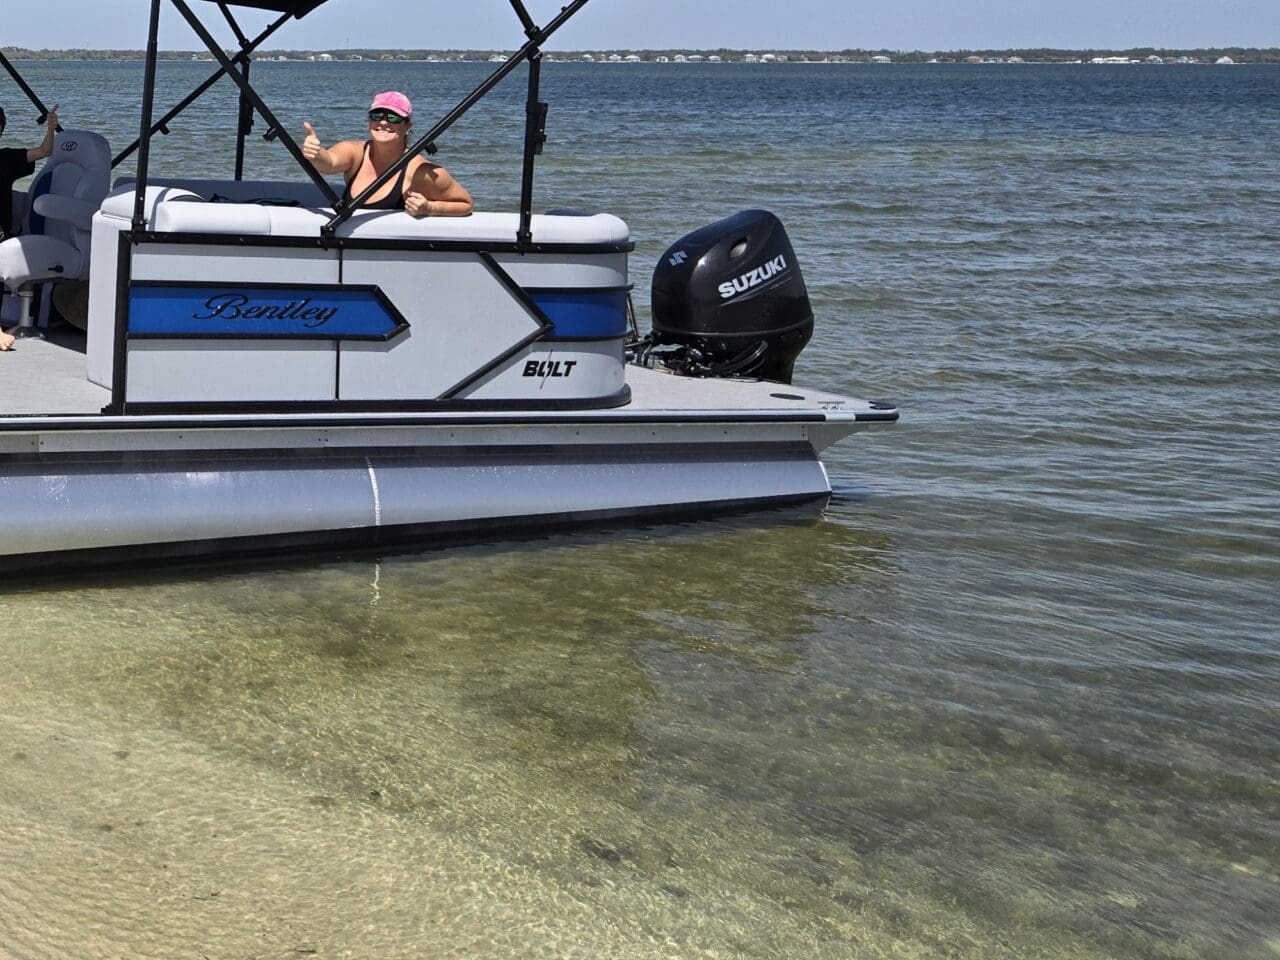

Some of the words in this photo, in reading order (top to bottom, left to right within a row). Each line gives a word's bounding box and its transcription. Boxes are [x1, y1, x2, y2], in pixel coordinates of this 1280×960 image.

[718, 254, 787, 299] SUZUKI
[192, 293, 339, 328] Bentley
[522, 360, 577, 377] BOLT
